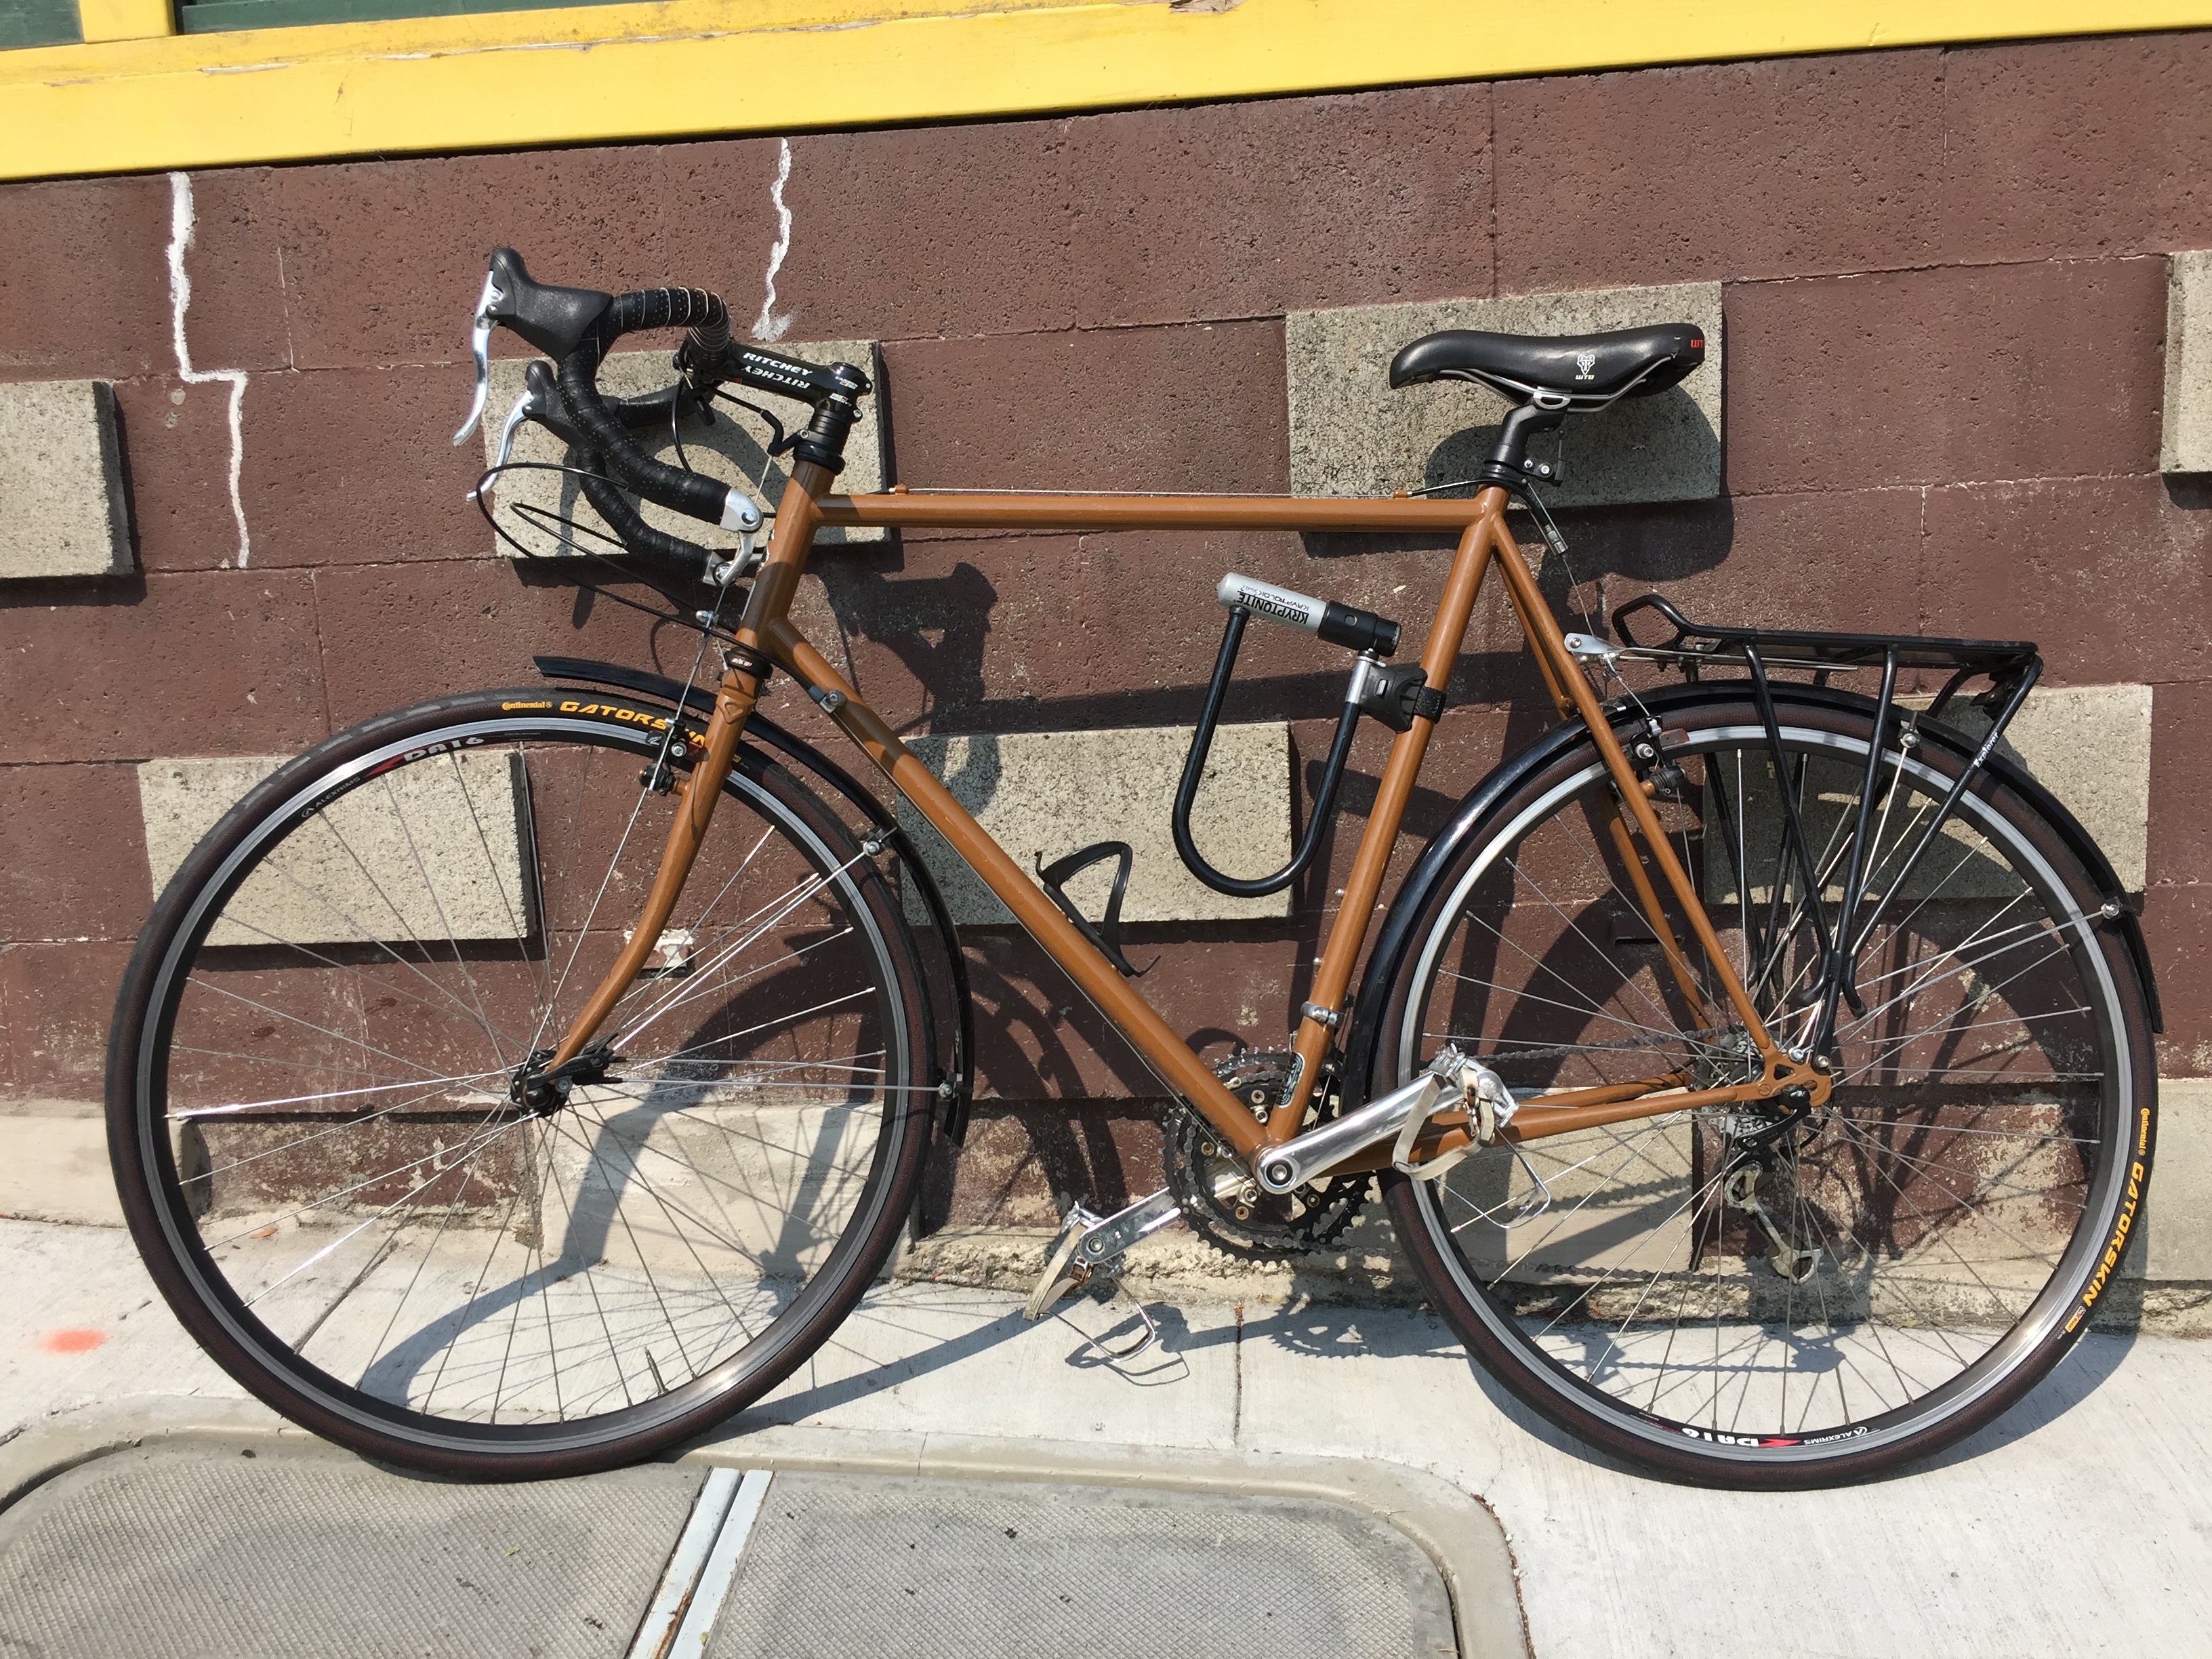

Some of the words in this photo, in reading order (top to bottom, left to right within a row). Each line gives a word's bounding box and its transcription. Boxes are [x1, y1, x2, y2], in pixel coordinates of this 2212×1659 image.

[1690, 339, 1705, 348] WT
[743, 352, 813, 377] RITCHEY
[743, 365, 812, 390] RITCHEY
[1236, 592, 1310, 625] KRYPTONITE
[1259, 590, 1310, 611] KRYPTOLOK
[501, 701, 546, 711] Continental
[1973, 731, 2000, 769] Explorer
[315, 776, 361, 807] ALEXRIMS
[2138, 1107, 2150, 1150] Continental
[2083, 1161, 2145, 1307] GATORSKIN
[1804, 1430, 1853, 1446] ALEXRIMS
